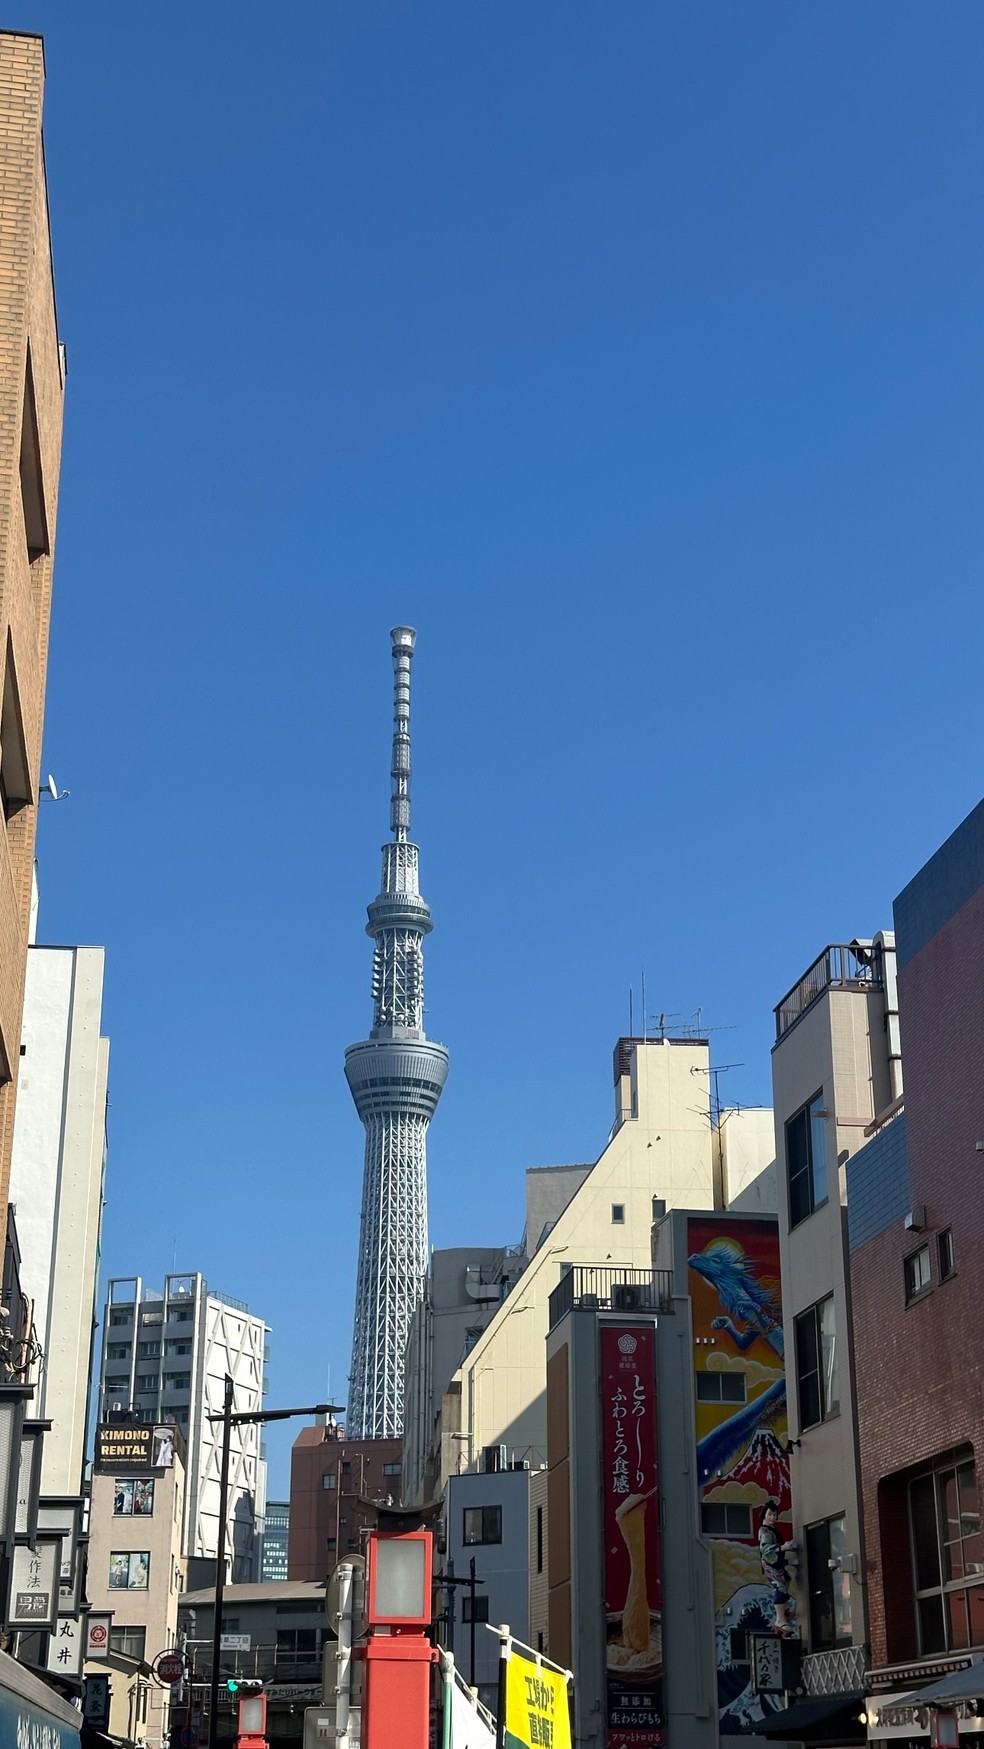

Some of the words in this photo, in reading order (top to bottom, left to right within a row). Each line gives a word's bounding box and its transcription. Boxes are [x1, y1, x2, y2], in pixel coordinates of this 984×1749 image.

[100, 1430, 150, 1440] KIMONO
[611, 1387, 630, 1493] ふわとろ食感
[101, 1445, 148, 1455] RENTAL
[56, 1621, 74, 1664] 丸井
[160, 1663, 182, 1675] 消火栓
[620, 1695, 652, 1706] 無添加
[610, 1711, 661, 1725] 生わらびもち
